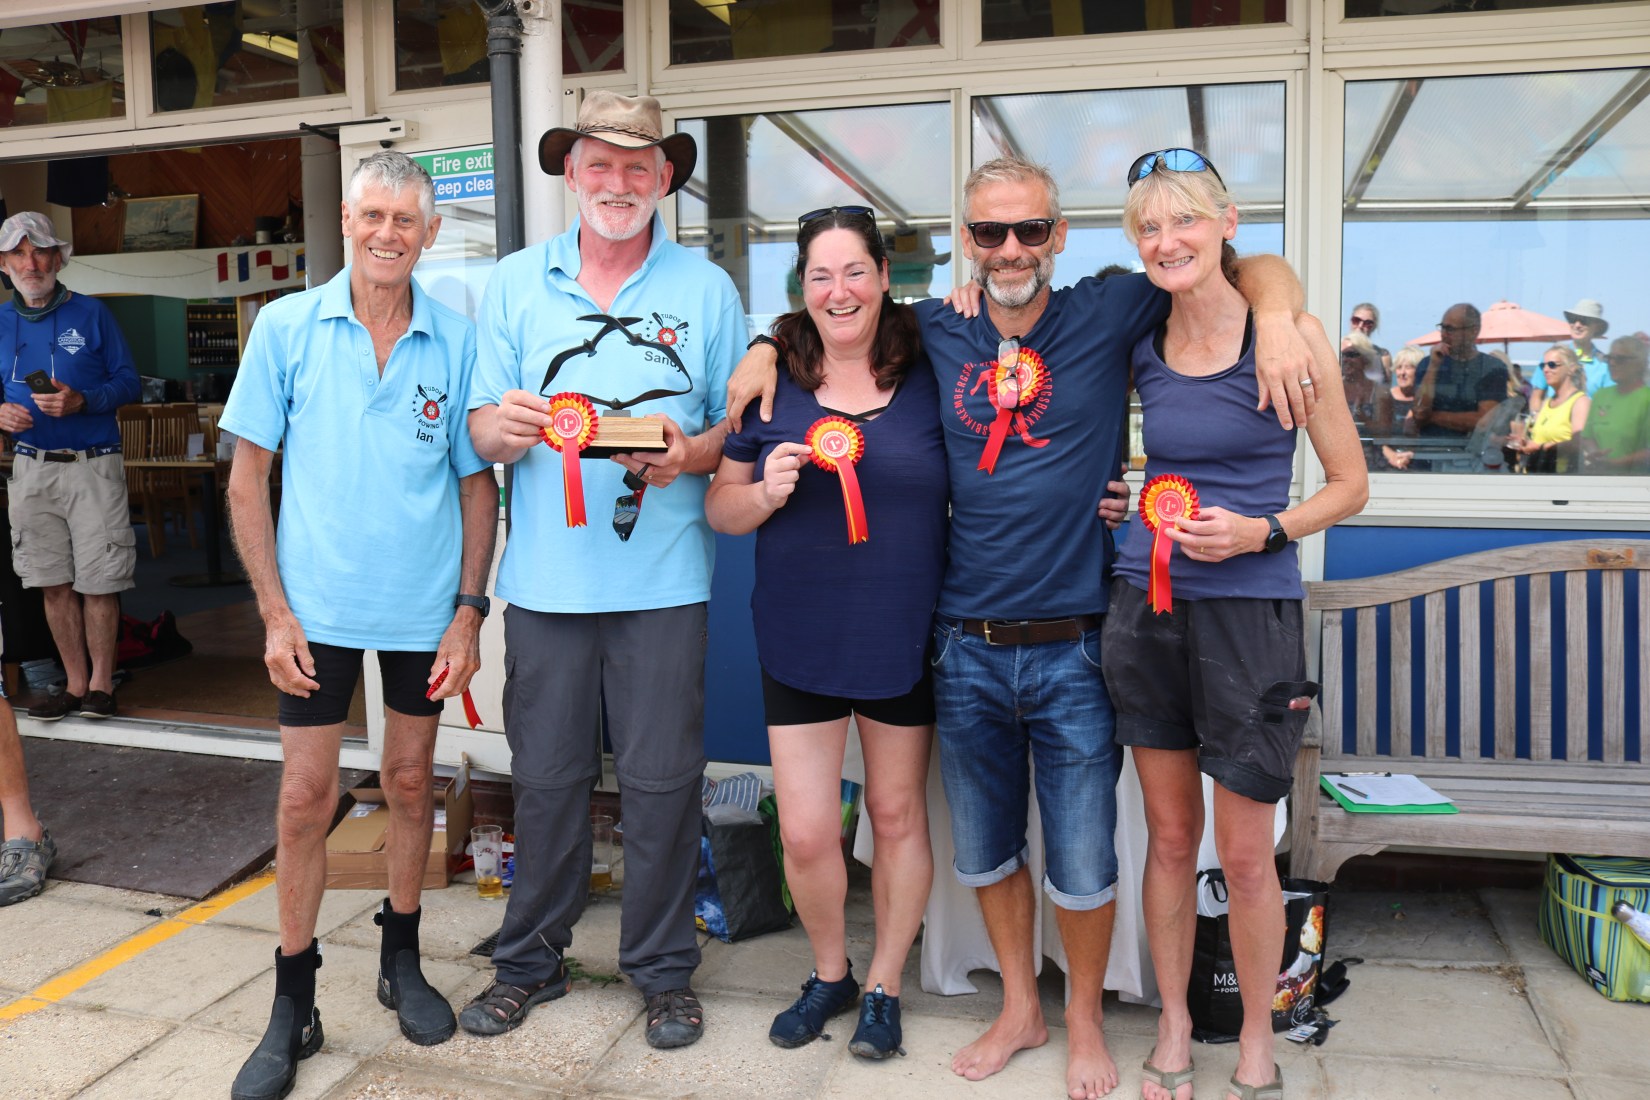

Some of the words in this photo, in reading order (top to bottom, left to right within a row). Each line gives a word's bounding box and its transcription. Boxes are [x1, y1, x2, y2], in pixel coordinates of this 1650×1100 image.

[433, 156, 461, 173] Fire
[465, 152, 492, 169] exit
[465, 177, 494, 192] clea
[661, 313, 681, 323] TUDOR
[424, 386, 442, 395] TUDOR
[418, 418, 440, 429] ROWING
[416, 428, 434, 443] Ian
[1214, 972, 1238, 986] M&
